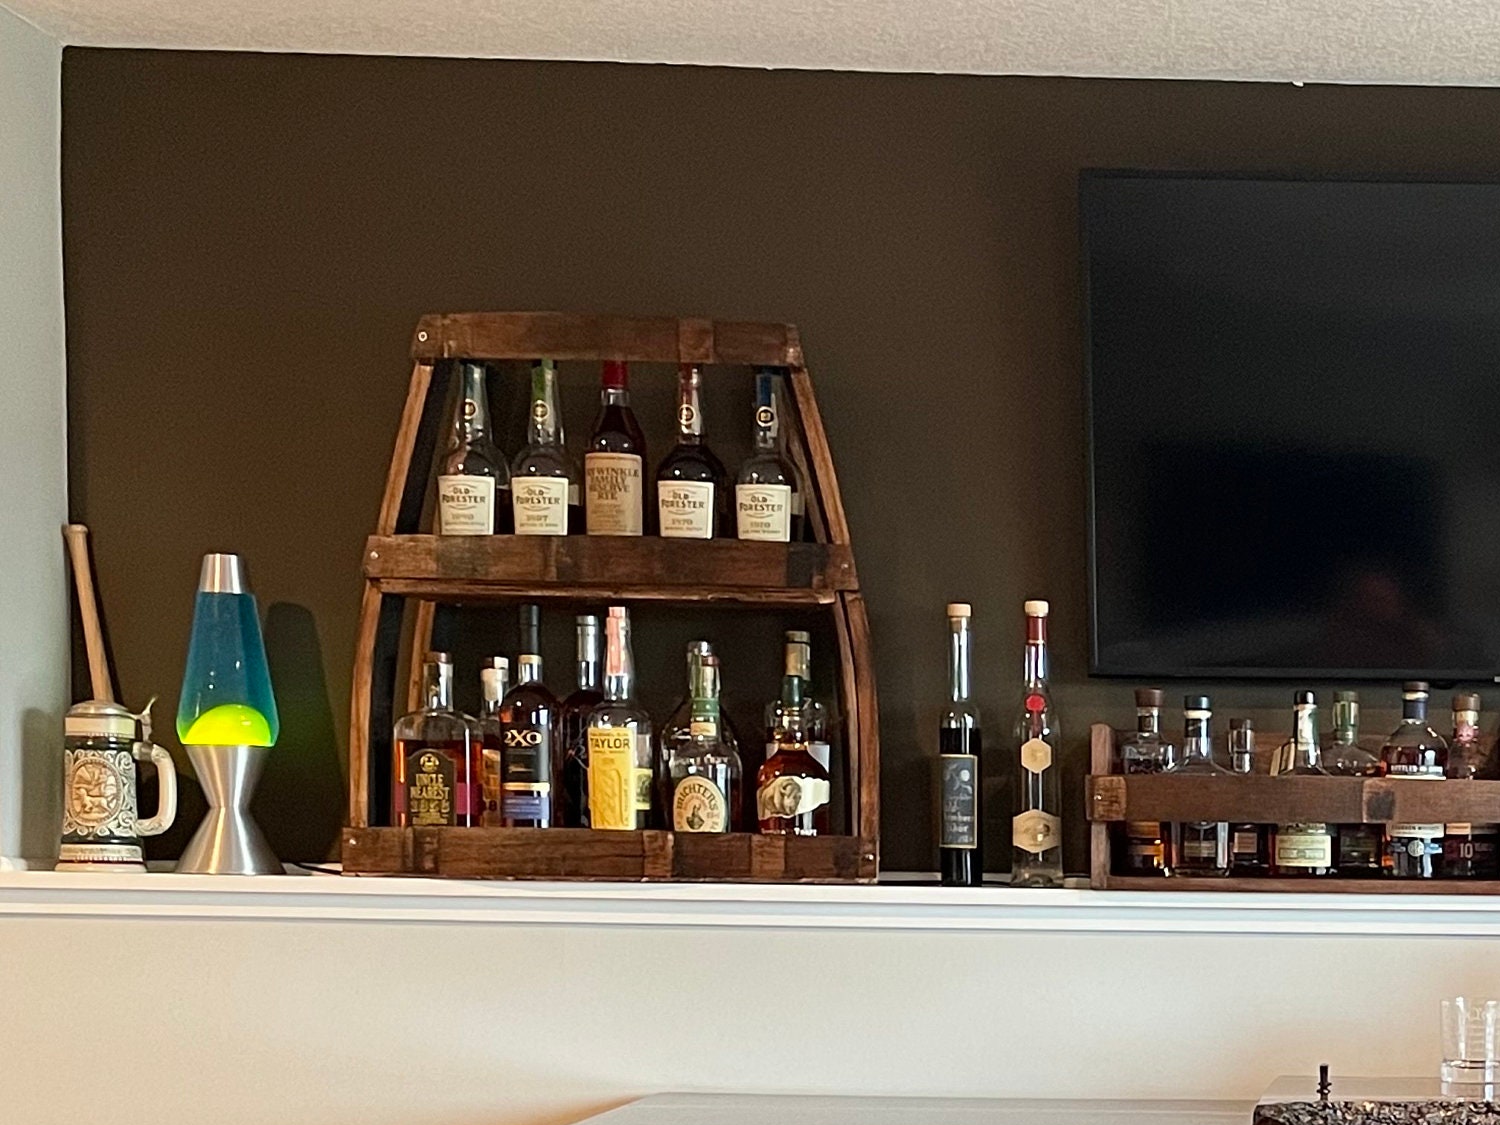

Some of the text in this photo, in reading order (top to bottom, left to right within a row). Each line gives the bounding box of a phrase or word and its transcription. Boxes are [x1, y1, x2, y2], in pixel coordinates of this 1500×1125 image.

[452, 486, 471, 495] OLD
[526, 487, 545, 496] OLD
[672, 491, 690, 500] OLD
[441, 494, 486, 504] FORESTER
[515, 495, 561, 505] FORESTER
[660, 499, 705, 509] FORESTER
[750, 495, 768, 504] OLD
[739, 502, 783, 513] FORESTER
[503, 729, 543, 748] 2XO
[590, 737, 631, 750] TAYLOR
[415, 773, 444, 787] UNCLE
[410, 786, 450, 800] NEAREST
[1459, 842, 1474, 859] 10
